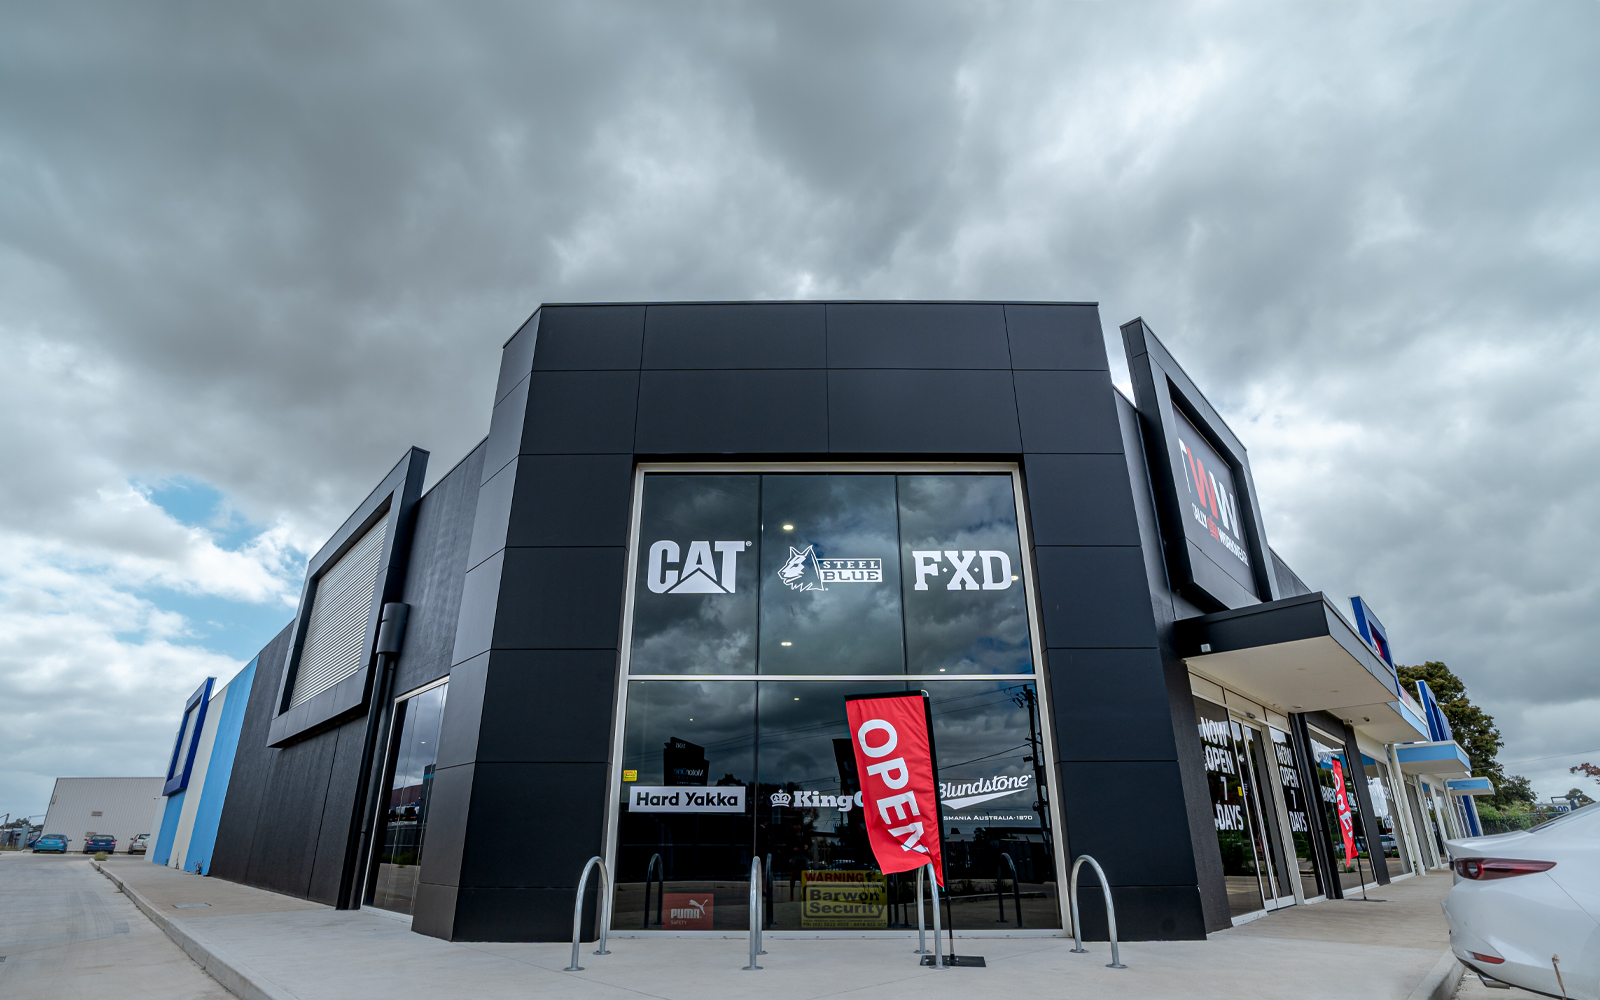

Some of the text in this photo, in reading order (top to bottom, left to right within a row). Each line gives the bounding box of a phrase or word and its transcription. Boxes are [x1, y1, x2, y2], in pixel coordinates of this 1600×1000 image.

[647, 540, 745, 593] CAT
[822, 561, 878, 569] STEEL
[822, 571, 879, 580] BLUE
[1200, 716, 1228, 747] NOW
[1205, 745, 1235, 775] OPEN
[1274, 743, 1294, 767] NOW
[857, 718, 931, 853] OPEN
[1279, 765, 1299, 789] OPEN
[636, 792, 738, 806] Hard Yakka
[1220, 776, 1228, 801] 7
[1290, 789, 1297, 809] 7
[793, 790, 864, 812] King
[1216, 804, 1244, 831] DAYS
[1288, 810, 1308, 832] DAYS
[804, 872, 865, 882] WARNING
[809, 889, 880, 901] Barwon
[670, 908, 700, 919] PUMA
[809, 901, 885, 917] Security
